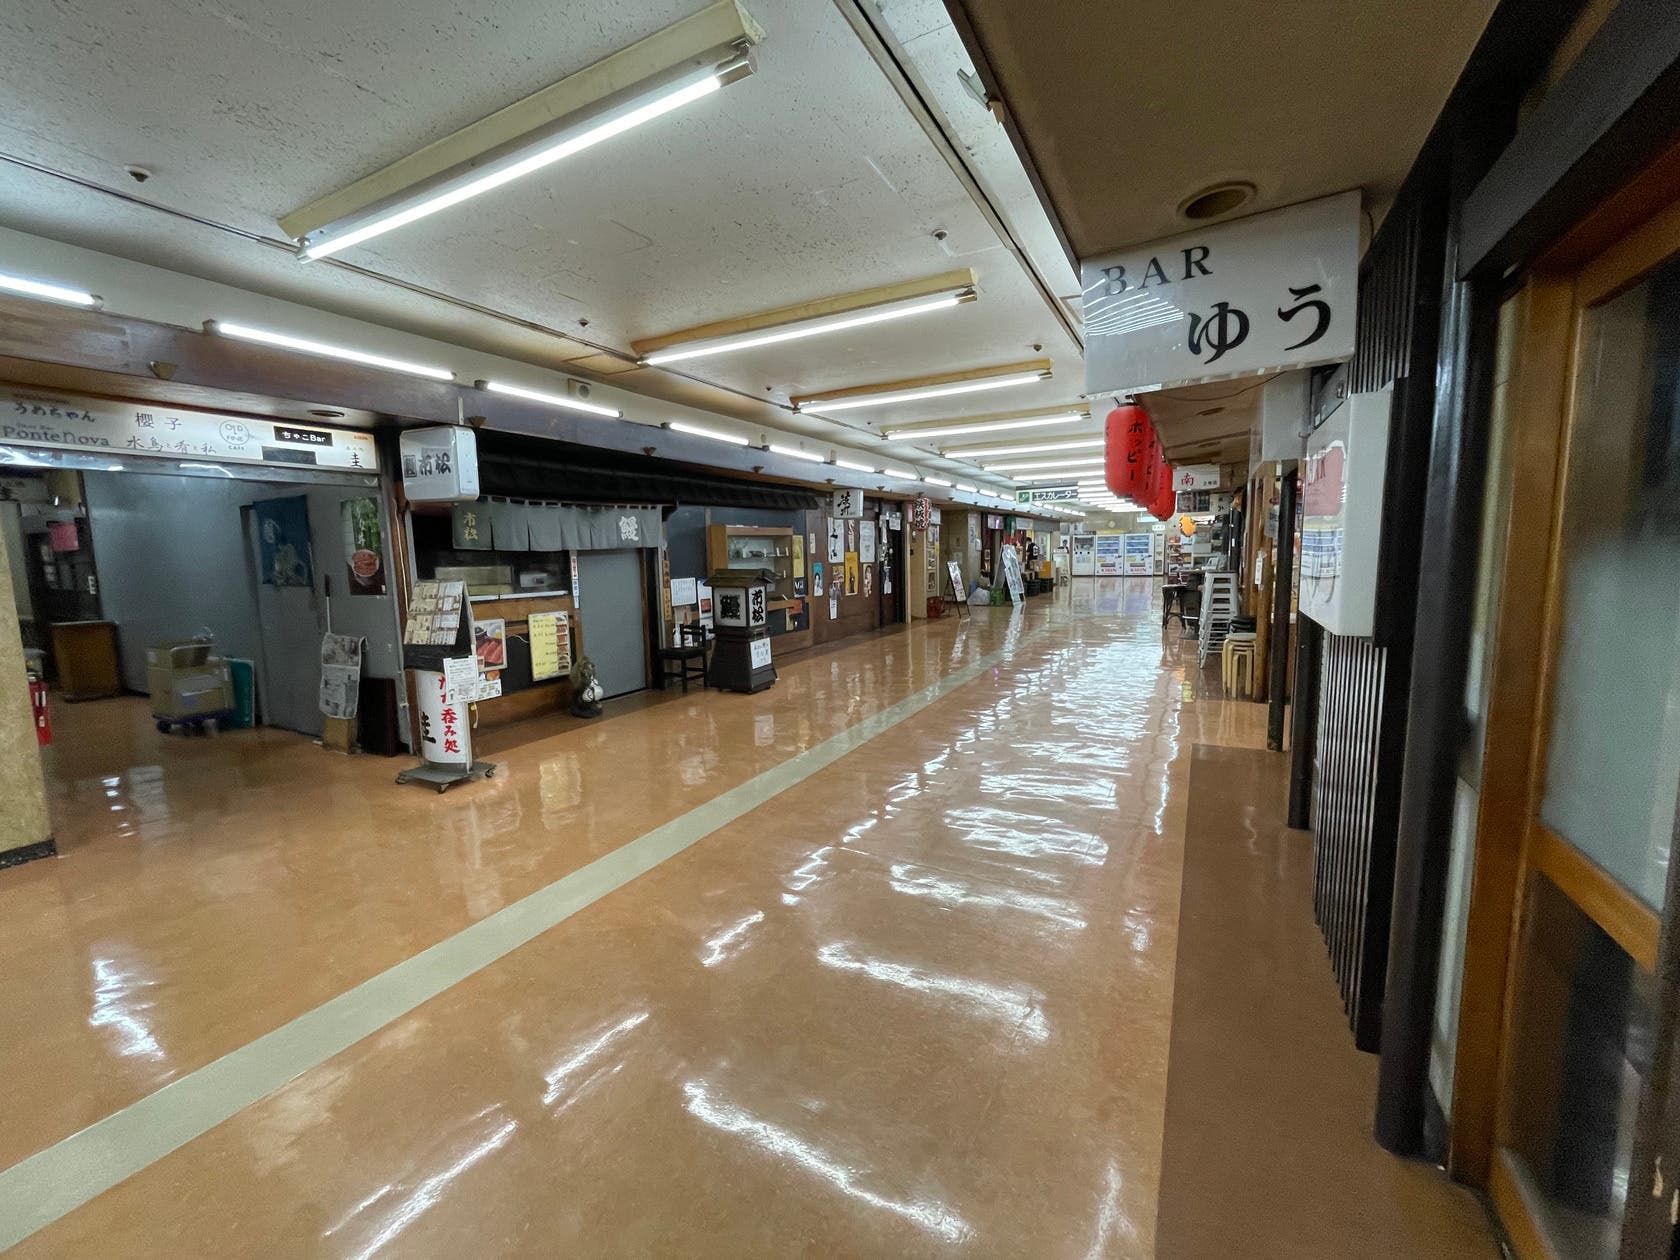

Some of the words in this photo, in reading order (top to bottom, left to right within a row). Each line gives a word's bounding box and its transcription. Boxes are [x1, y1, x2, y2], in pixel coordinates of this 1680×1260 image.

[1101, 246, 1213, 296] BAR
[1188, 284, 1331, 365] ゆう
[281, 430, 326, 443] ちゃこBar
[1127, 422, 1144, 482] ホッピー
[1181, 472, 1194, 486] 南
[1034, 490, 1078, 501] エスカレーター
